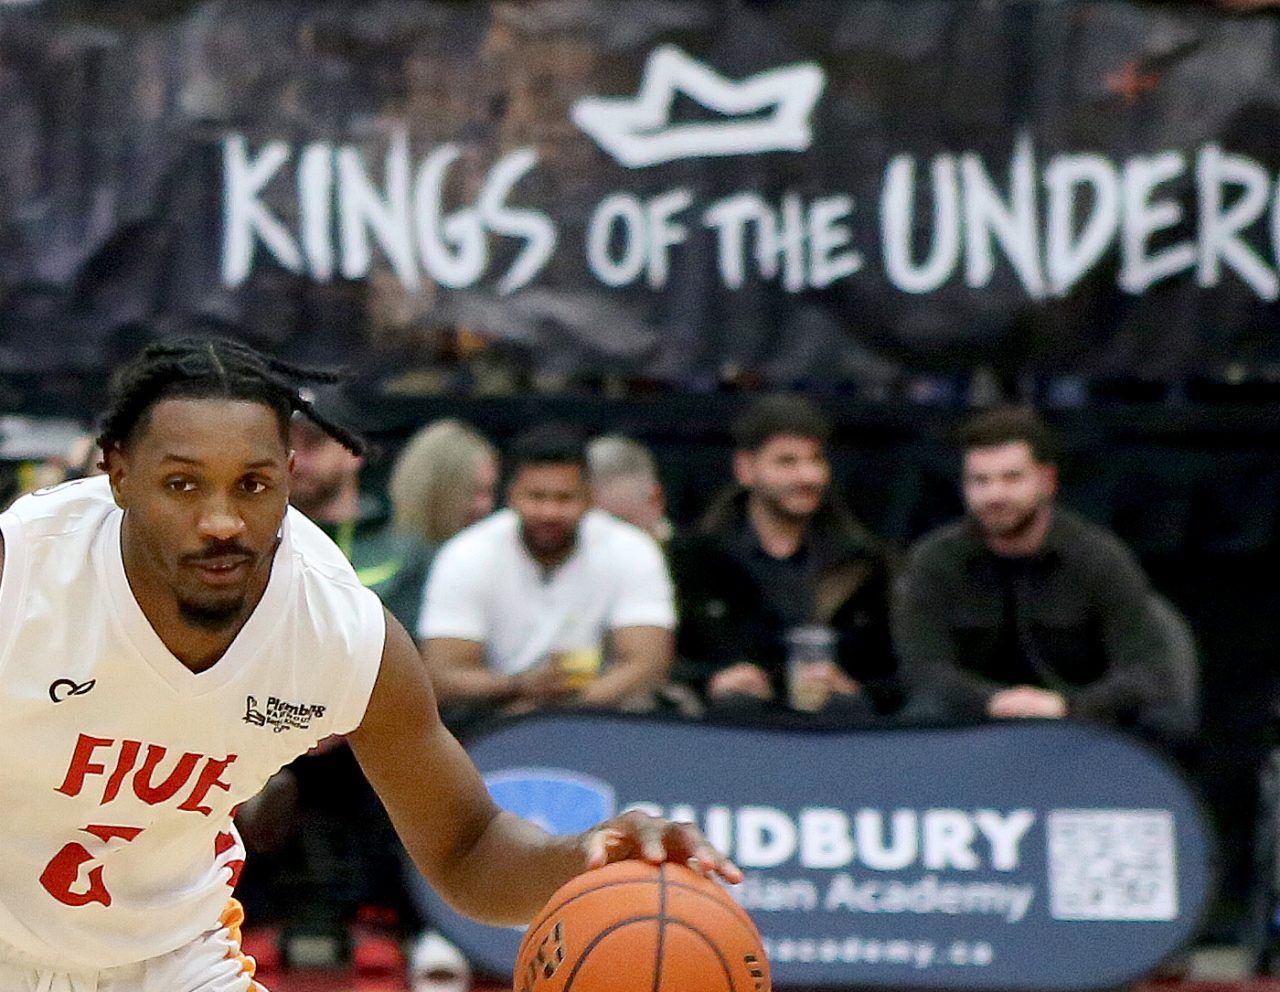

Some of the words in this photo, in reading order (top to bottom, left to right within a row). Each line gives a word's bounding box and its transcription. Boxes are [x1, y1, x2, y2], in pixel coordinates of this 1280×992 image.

[222, 122, 557, 297] KINGS
[586, 188, 694, 290] OF
[703, 189, 865, 293] THE
[880, 126, 1280, 304] UNDER
[825, 873, 1034, 924] Academy
